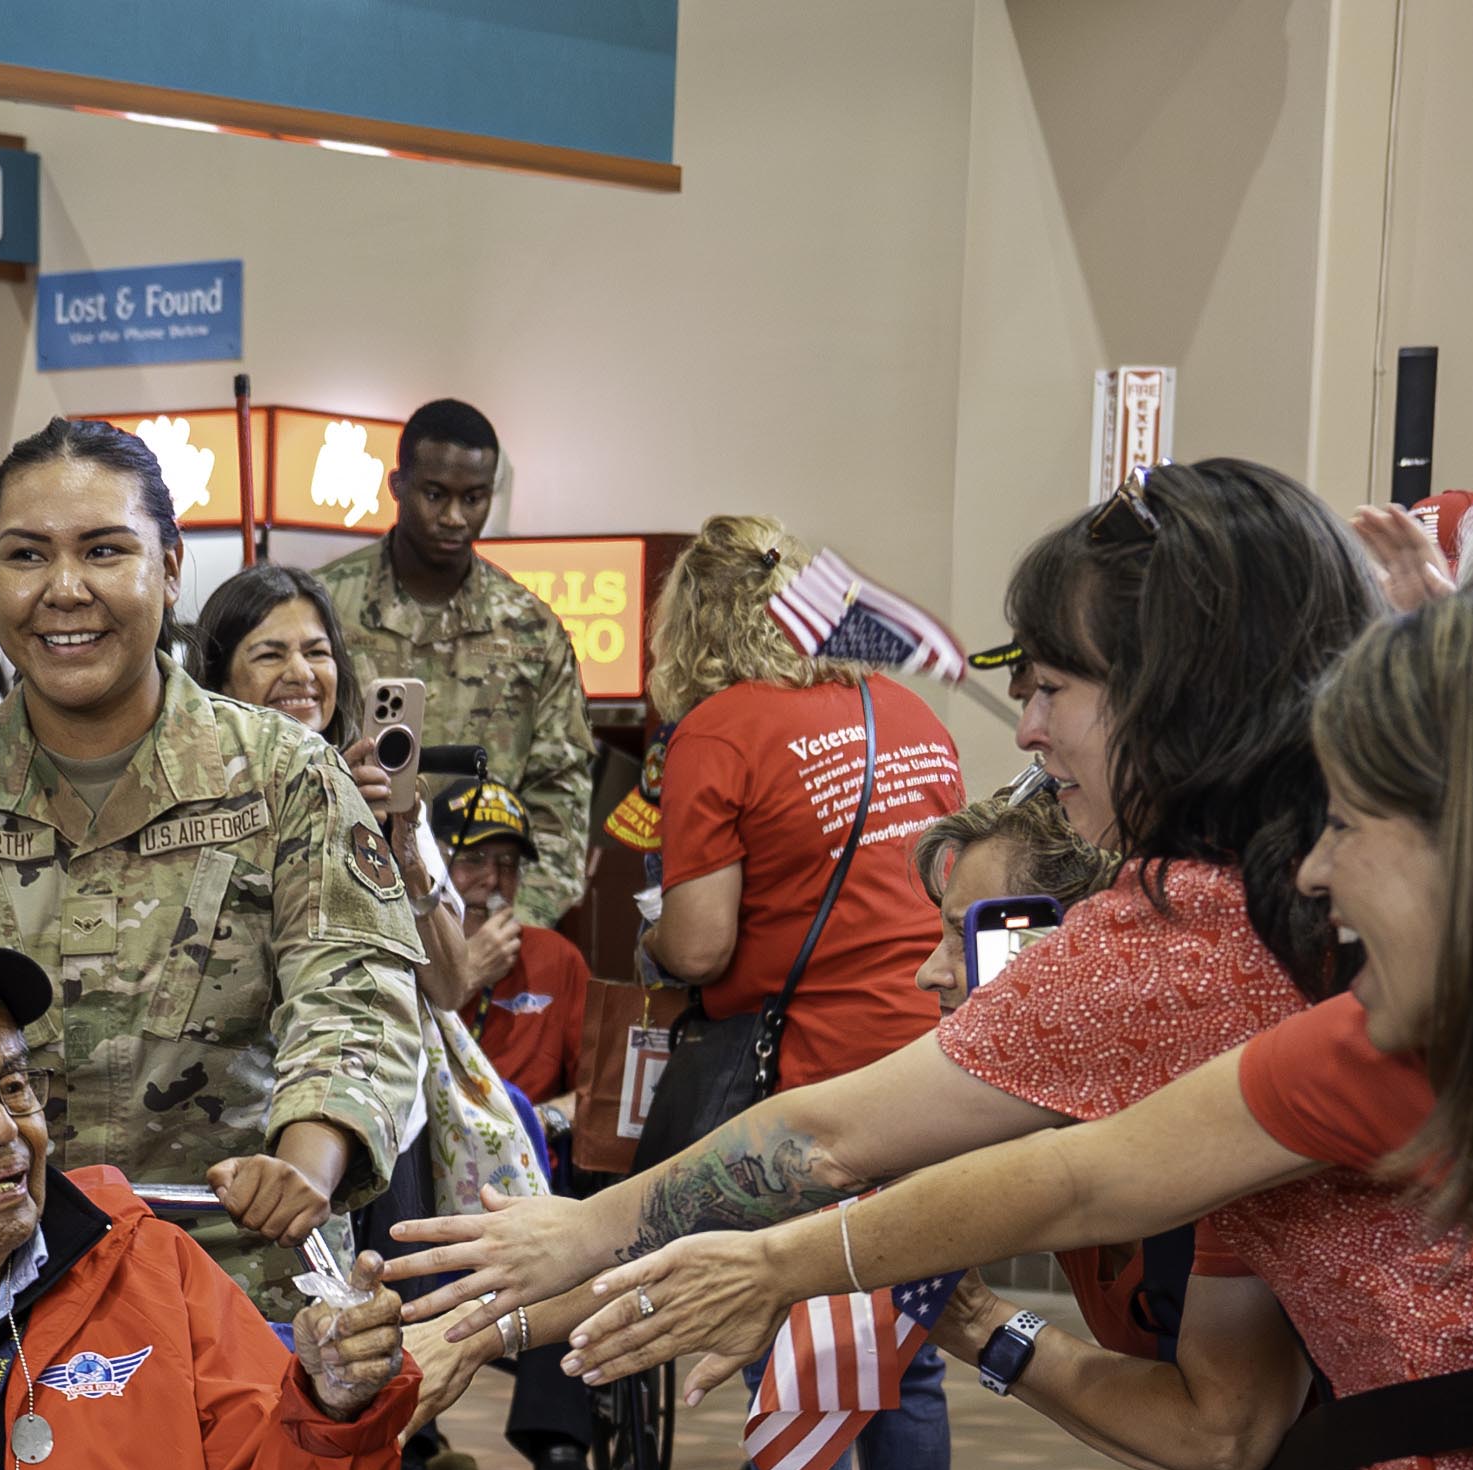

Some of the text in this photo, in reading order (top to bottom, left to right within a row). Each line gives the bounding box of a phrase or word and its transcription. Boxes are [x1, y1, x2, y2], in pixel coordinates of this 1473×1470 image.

[54, 278, 223, 324] Lost & Found
[787, 724, 867, 762] Veteran
[814, 762, 851, 790] person
[899, 743, 929, 758] blank
[811, 784, 841, 805] made
[910, 756, 942, 771] United
[816, 804, 830, 820] of
[876, 779, 892, 794] for
[893, 778, 906, 790] an
[906, 772, 940, 787] amount
[940, 772, 951, 785] up
[145, 805, 262, 852] U.S. AIR FORCE
[822, 817, 844, 834] and
[887, 793, 908, 807] their
